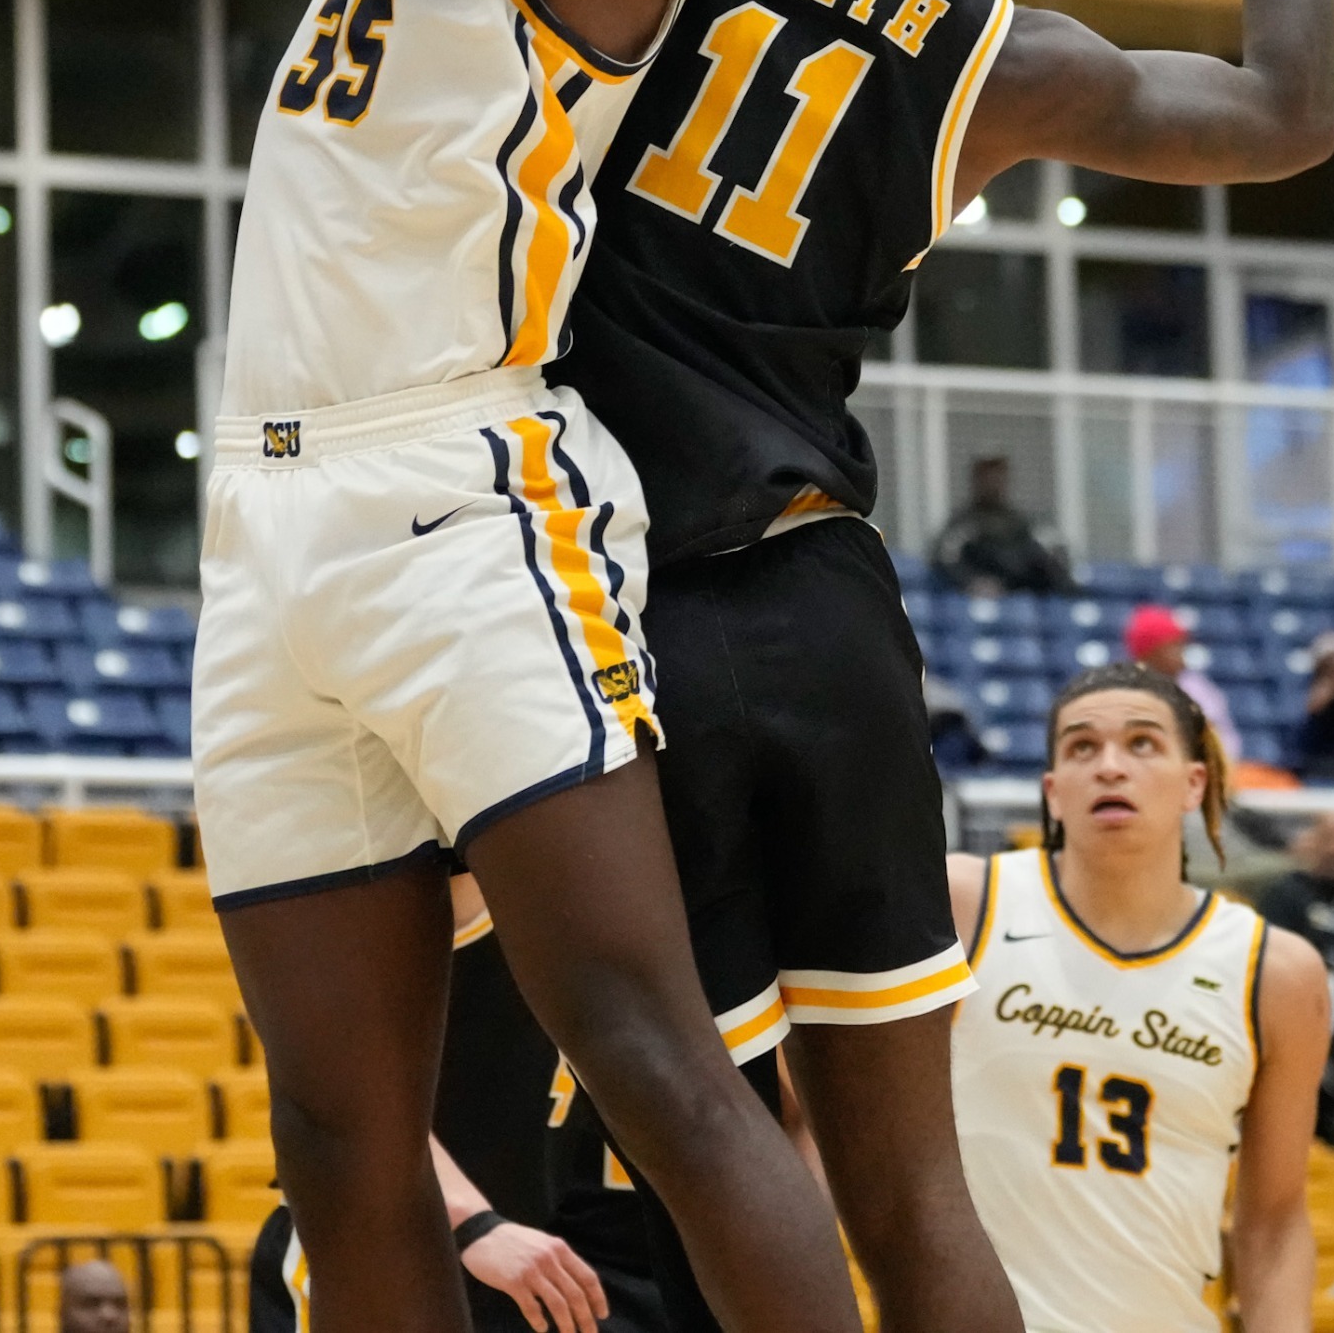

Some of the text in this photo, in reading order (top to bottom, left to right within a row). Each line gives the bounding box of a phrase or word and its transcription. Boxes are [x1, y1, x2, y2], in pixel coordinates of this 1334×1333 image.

[624, 0, 876, 269] 11
[995, 983, 1223, 1067] Coppin State
[1050, 1061, 1157, 1179] 13
